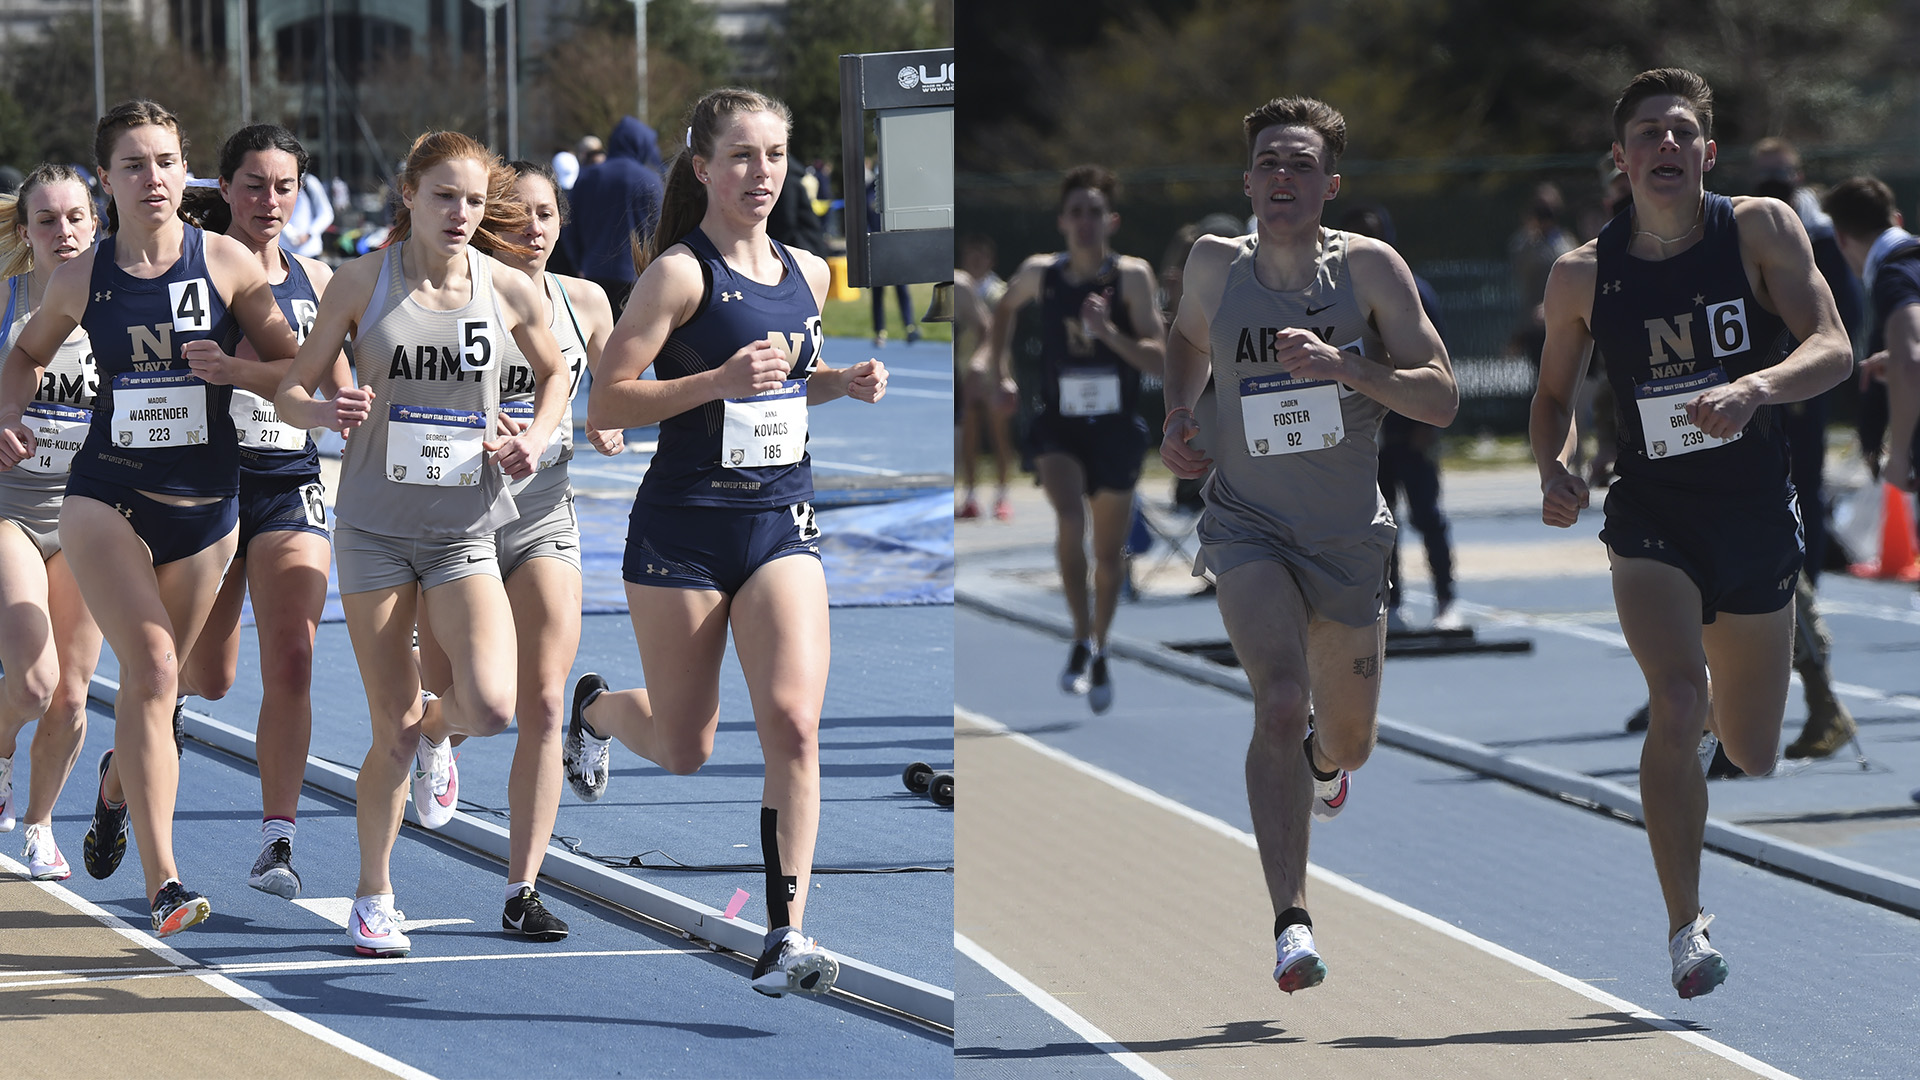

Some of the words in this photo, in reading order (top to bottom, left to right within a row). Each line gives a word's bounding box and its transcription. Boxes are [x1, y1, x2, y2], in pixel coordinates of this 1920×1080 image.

[919, 62, 954, 85] U
[177, 282, 205, 326] 4
[1713, 304, 1744, 351] 6
[127, 322, 173, 362] N
[465, 322, 491, 367] 5
[1236, 326, 1335, 363] ARY
[1644, 312, 1695, 366] N
[133, 361, 172, 372] NAVY
[388, 345, 483, 382] ARM
[1651, 361, 1696, 379] NAVY
[1280, 399, 1299, 408] CADEN
[129, 407, 189, 422] WARRENDER
[1273, 410, 1310, 427] FOSTER
[149, 427, 170, 442] 223
[260, 429, 280, 443] 217
[754, 422, 788, 437] KOVACS
[35, 437, 82, 451] NING-KULICK
[425, 433, 447, 442] GEORGIA
[1287, 431, 1302, 447] 92
[1681, 430, 1704, 447] 239
[420, 445, 450, 459] JONES
[763, 444, 782, 459] 185
[39, 455, 51, 468] 14
[426, 466, 441, 480] 33
[788, 883, 796, 894] KT
